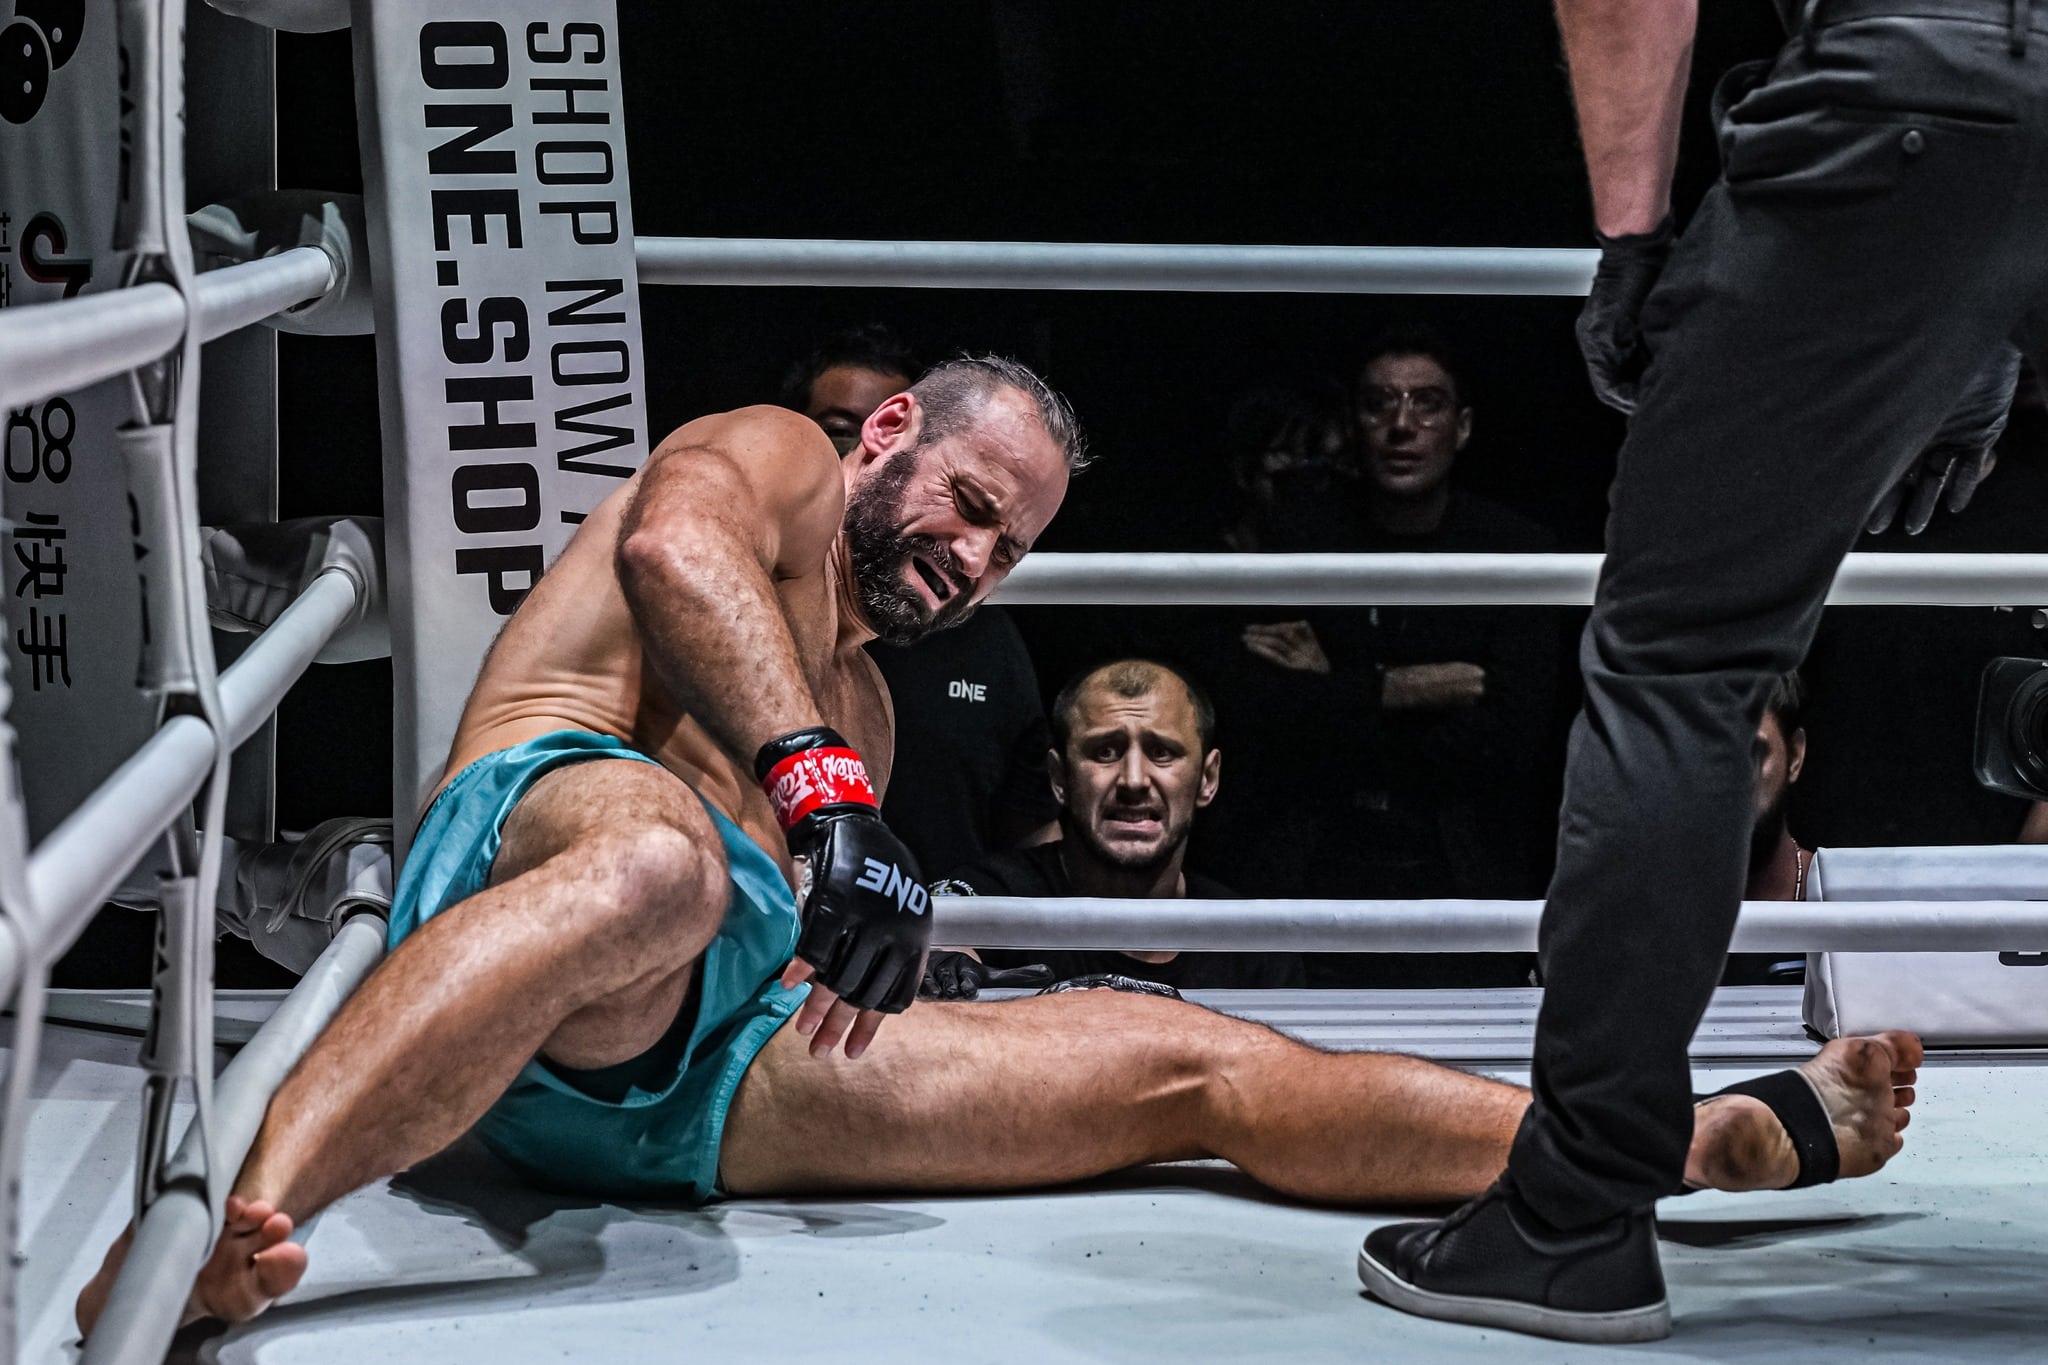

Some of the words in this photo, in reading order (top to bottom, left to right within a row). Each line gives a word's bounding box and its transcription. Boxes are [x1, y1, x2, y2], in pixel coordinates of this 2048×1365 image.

[526, 22, 619, 245] SHOP
[419, 21, 544, 616] ONE.SHOP
[545, 279, 637, 479] NOW
[13, 511, 72, 692] 快手
[948, 679, 987, 702] ONE
[855, 856, 928, 916] ONE
